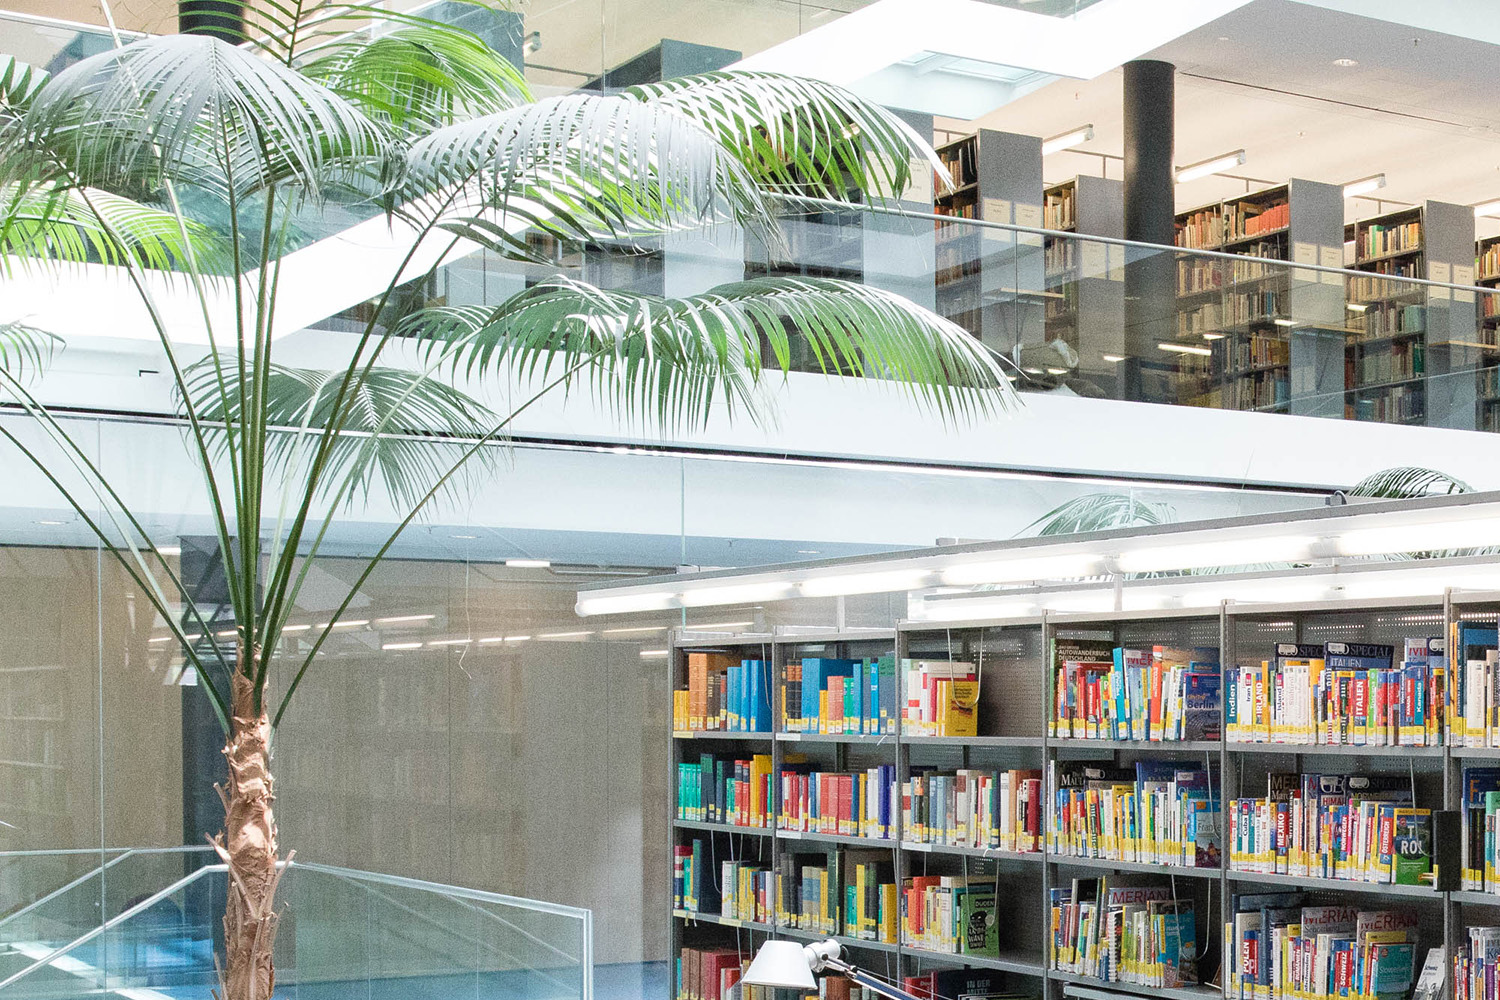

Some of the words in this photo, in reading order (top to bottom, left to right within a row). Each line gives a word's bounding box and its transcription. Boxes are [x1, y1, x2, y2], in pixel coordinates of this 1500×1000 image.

[1187, 700, 1214, 709] Berlin
[1356, 681, 1364, 717] ITALIEN
[1277, 813, 1285, 846] MEXIKO
[1381, 820, 1390, 854] ÖSTERREICH
[1112, 889, 1171, 904] MERIAN
[978, 980, 990, 988] DER
